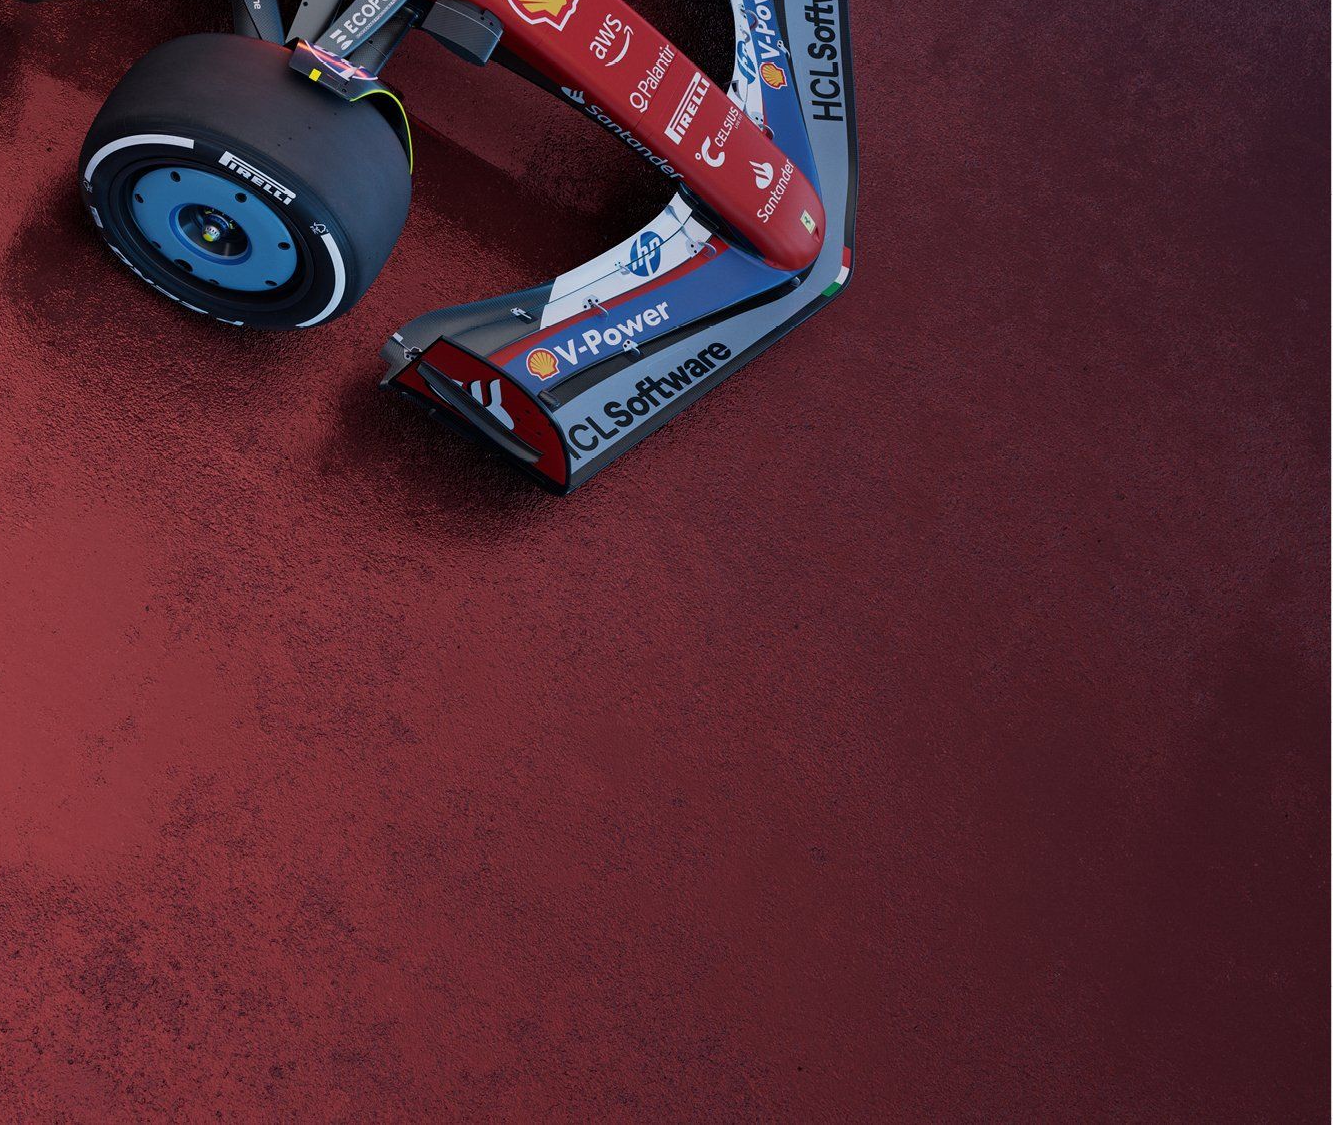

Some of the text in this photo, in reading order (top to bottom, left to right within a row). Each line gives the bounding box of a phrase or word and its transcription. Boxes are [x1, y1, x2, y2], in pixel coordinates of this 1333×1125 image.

[589, 13, 624, 61] aws
[638, 44, 678, 98] Palantir
[664, 72, 711, 144] PIRELLI
[714, 106, 740, 148] CELSIUS
[584, 104, 685, 180] Santander
[218, 151, 296, 206] PIRELLI
[757, 159, 796, 223] Santander
[630, 231, 661, 276] hp
[555, 300, 670, 366] V-Power
